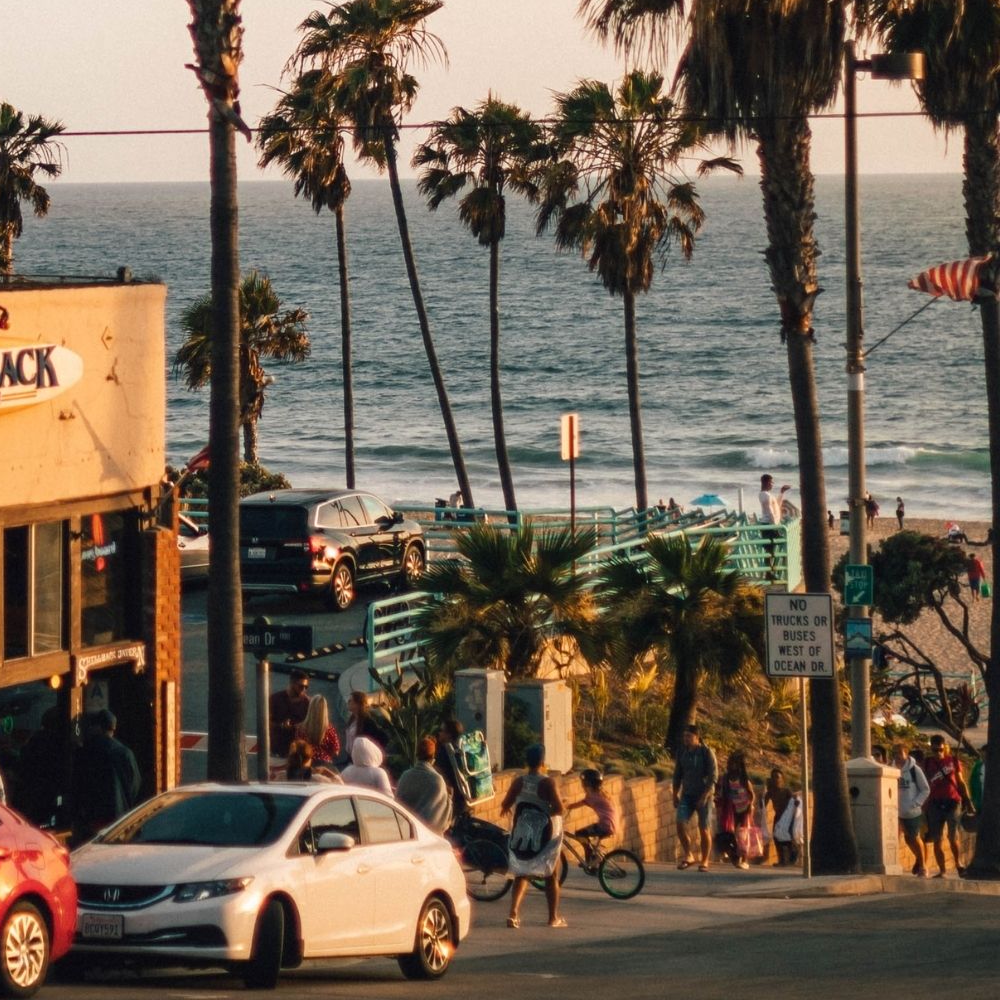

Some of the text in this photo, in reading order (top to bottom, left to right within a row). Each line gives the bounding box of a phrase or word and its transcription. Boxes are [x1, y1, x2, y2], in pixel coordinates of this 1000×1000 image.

[789, 599, 807, 611] NO
[772, 615, 828, 626] TRUCKS OR
[243, 634, 260, 645] ean
[264, 631, 276, 646] Dr
[783, 630, 816, 641] BUSES
[778, 645, 821, 657] WEST OF
[774, 660, 806, 672] OCEAN
